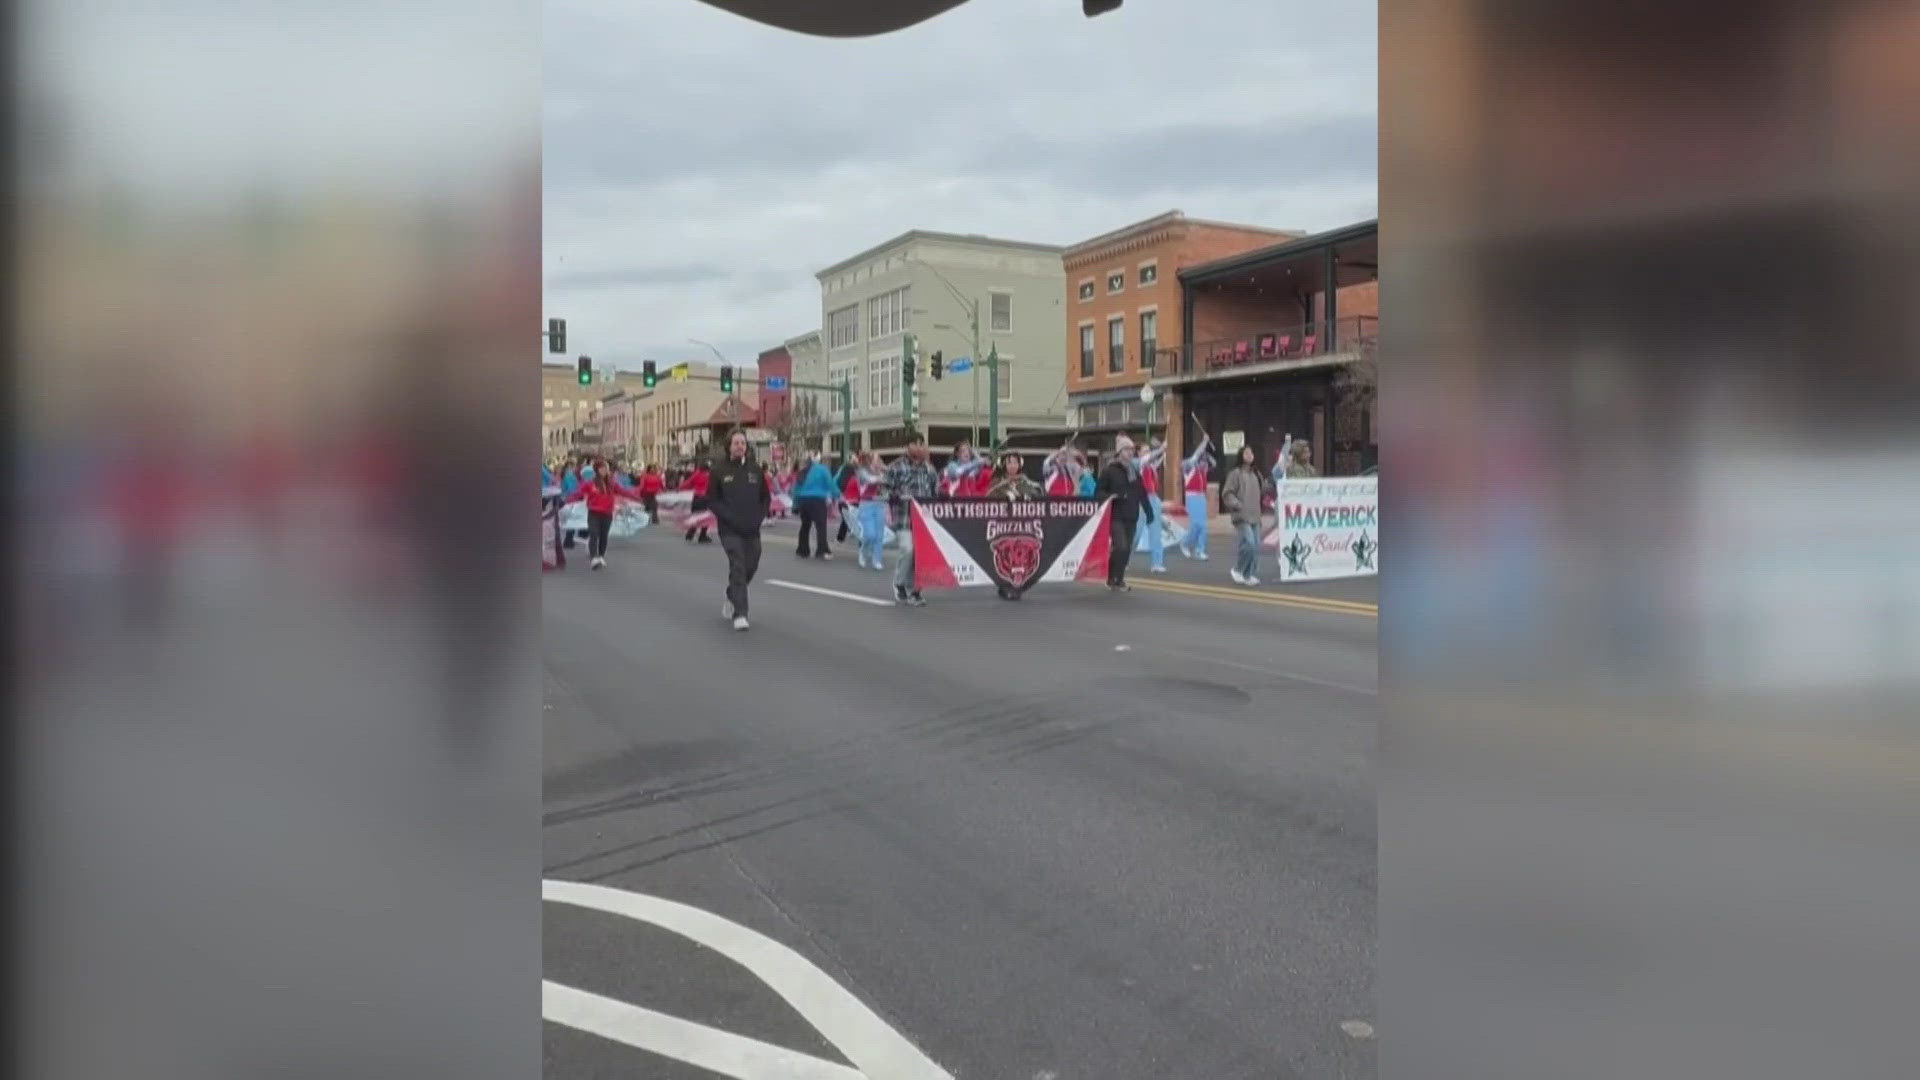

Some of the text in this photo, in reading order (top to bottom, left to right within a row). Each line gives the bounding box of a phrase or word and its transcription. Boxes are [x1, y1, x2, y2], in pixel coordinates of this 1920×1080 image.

[922, 501, 1100, 518] NORTHSIDE HIGH SCHOOL
[1284, 504, 1376, 529] MAVERICK
[986, 519, 1044, 541] GRIZZLIES
[1313, 531, 1354, 554] Band
